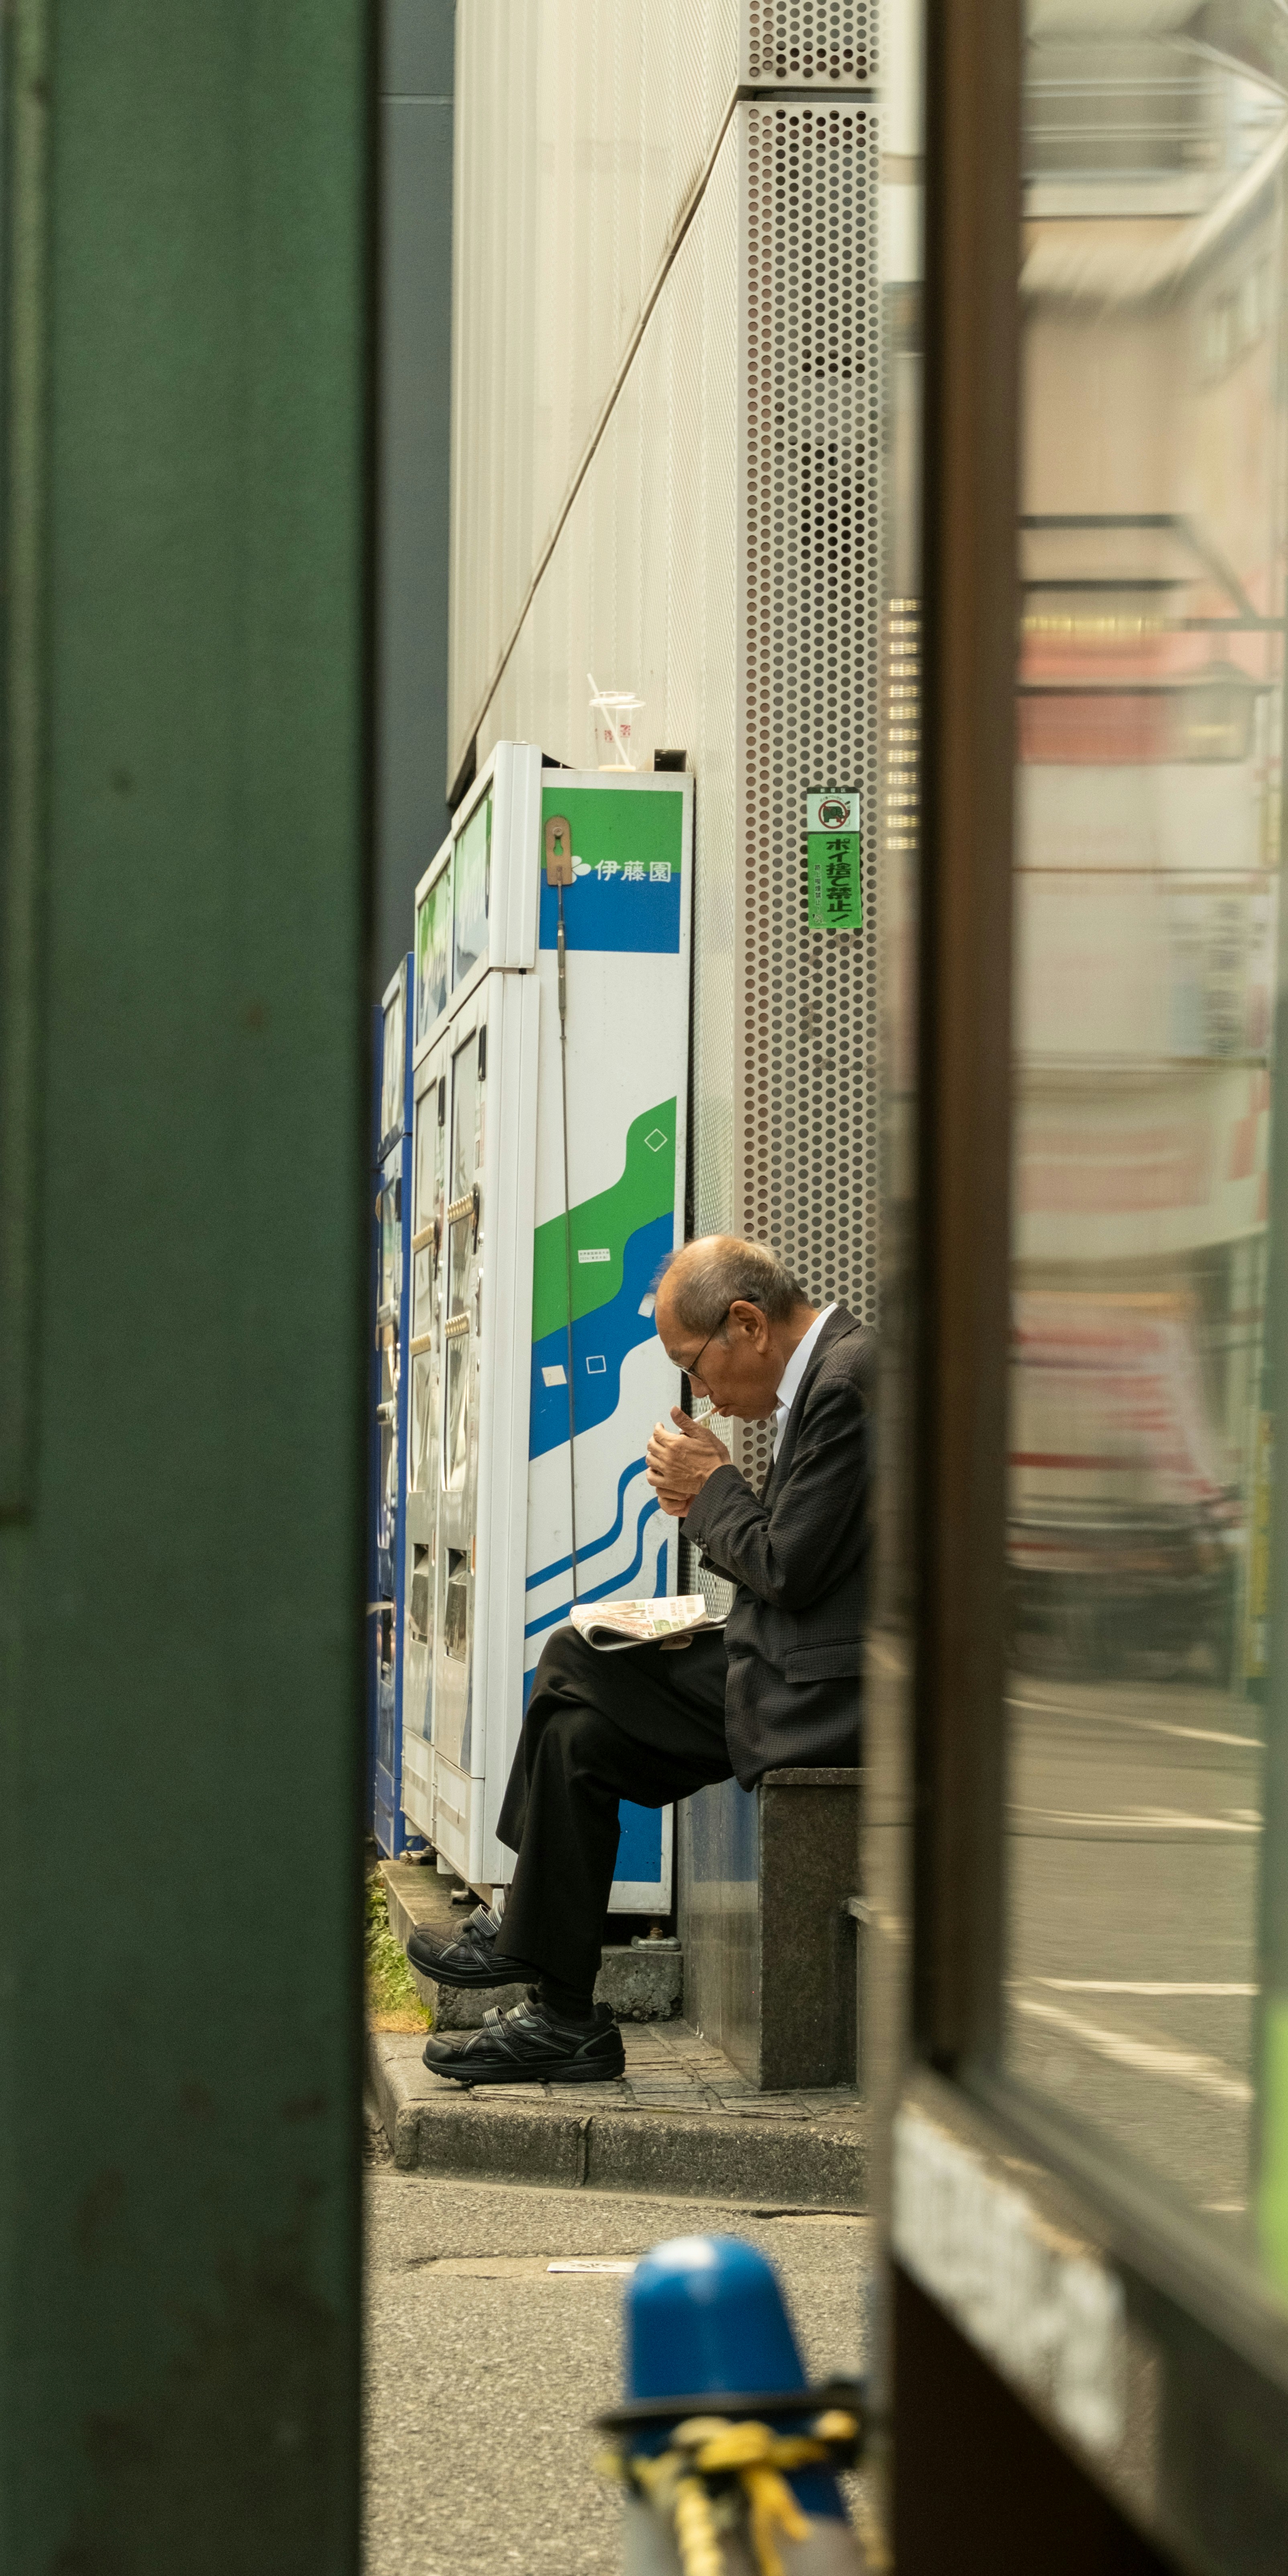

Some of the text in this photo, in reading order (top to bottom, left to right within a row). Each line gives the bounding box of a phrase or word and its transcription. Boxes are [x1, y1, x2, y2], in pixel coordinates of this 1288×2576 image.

[594, 860, 671, 883] 伊藤園
[826, 838, 852, 922] ポイ捨て禁止!
